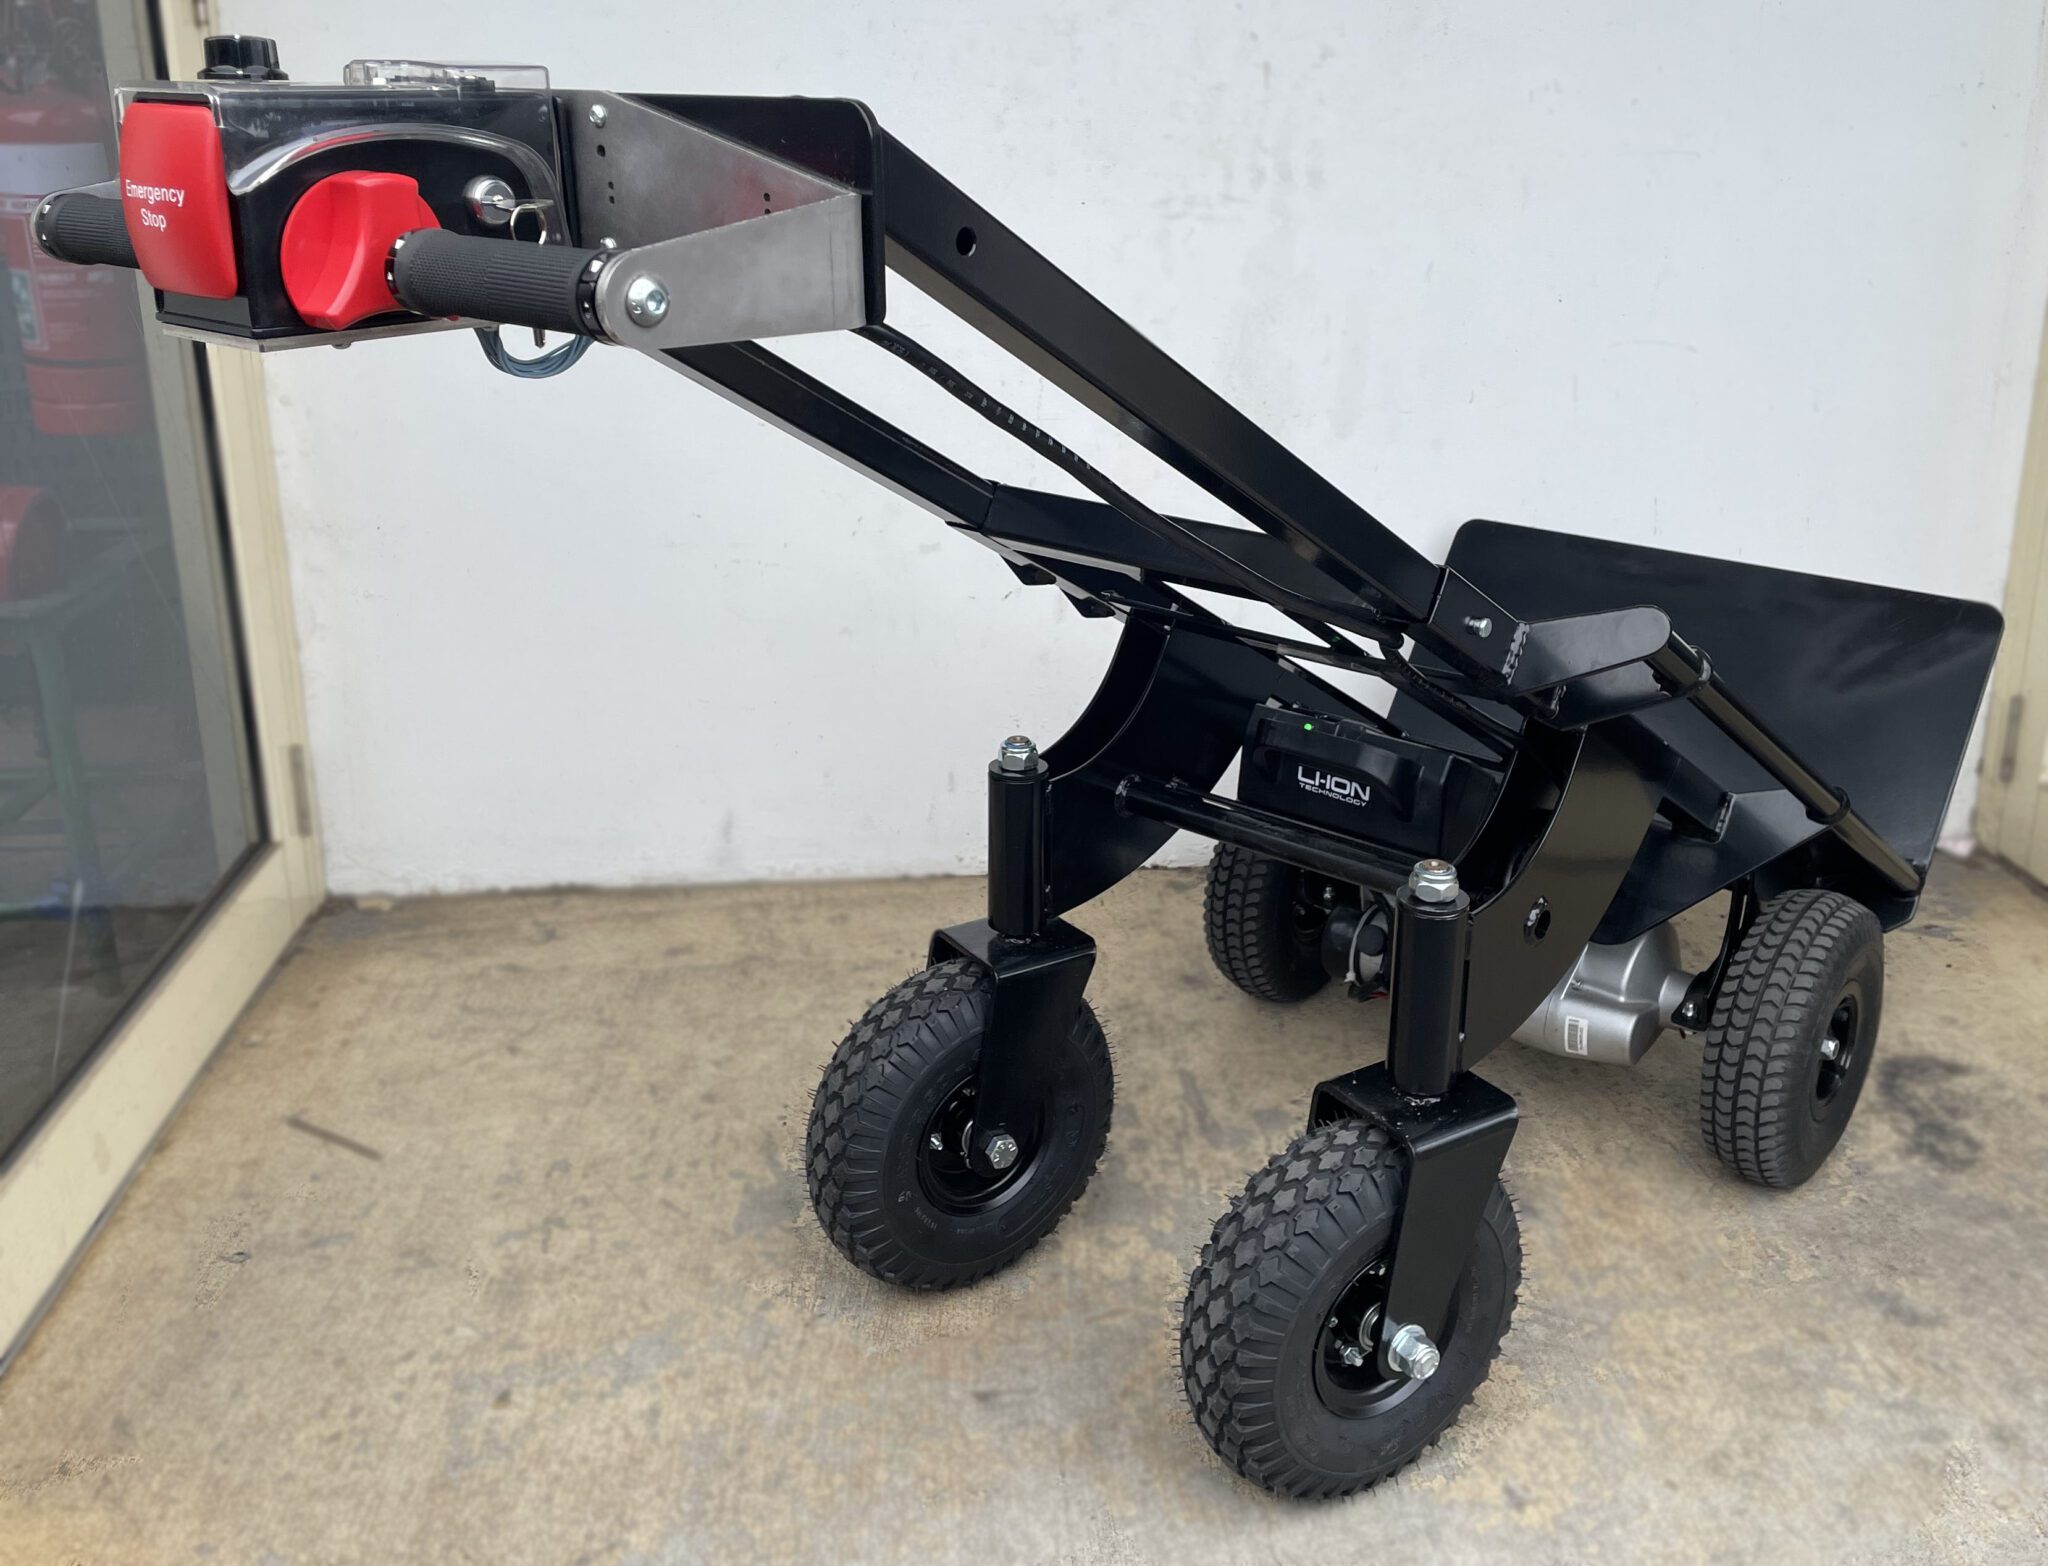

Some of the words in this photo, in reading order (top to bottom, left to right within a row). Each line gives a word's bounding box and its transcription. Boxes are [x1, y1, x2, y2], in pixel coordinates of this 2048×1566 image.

[125, 179, 185, 207] Emergency
[140, 208, 167, 232] Stop
[1297, 765, 1371, 802] LI-ION
[1298, 782, 1367, 808] TECHNOLOGY
